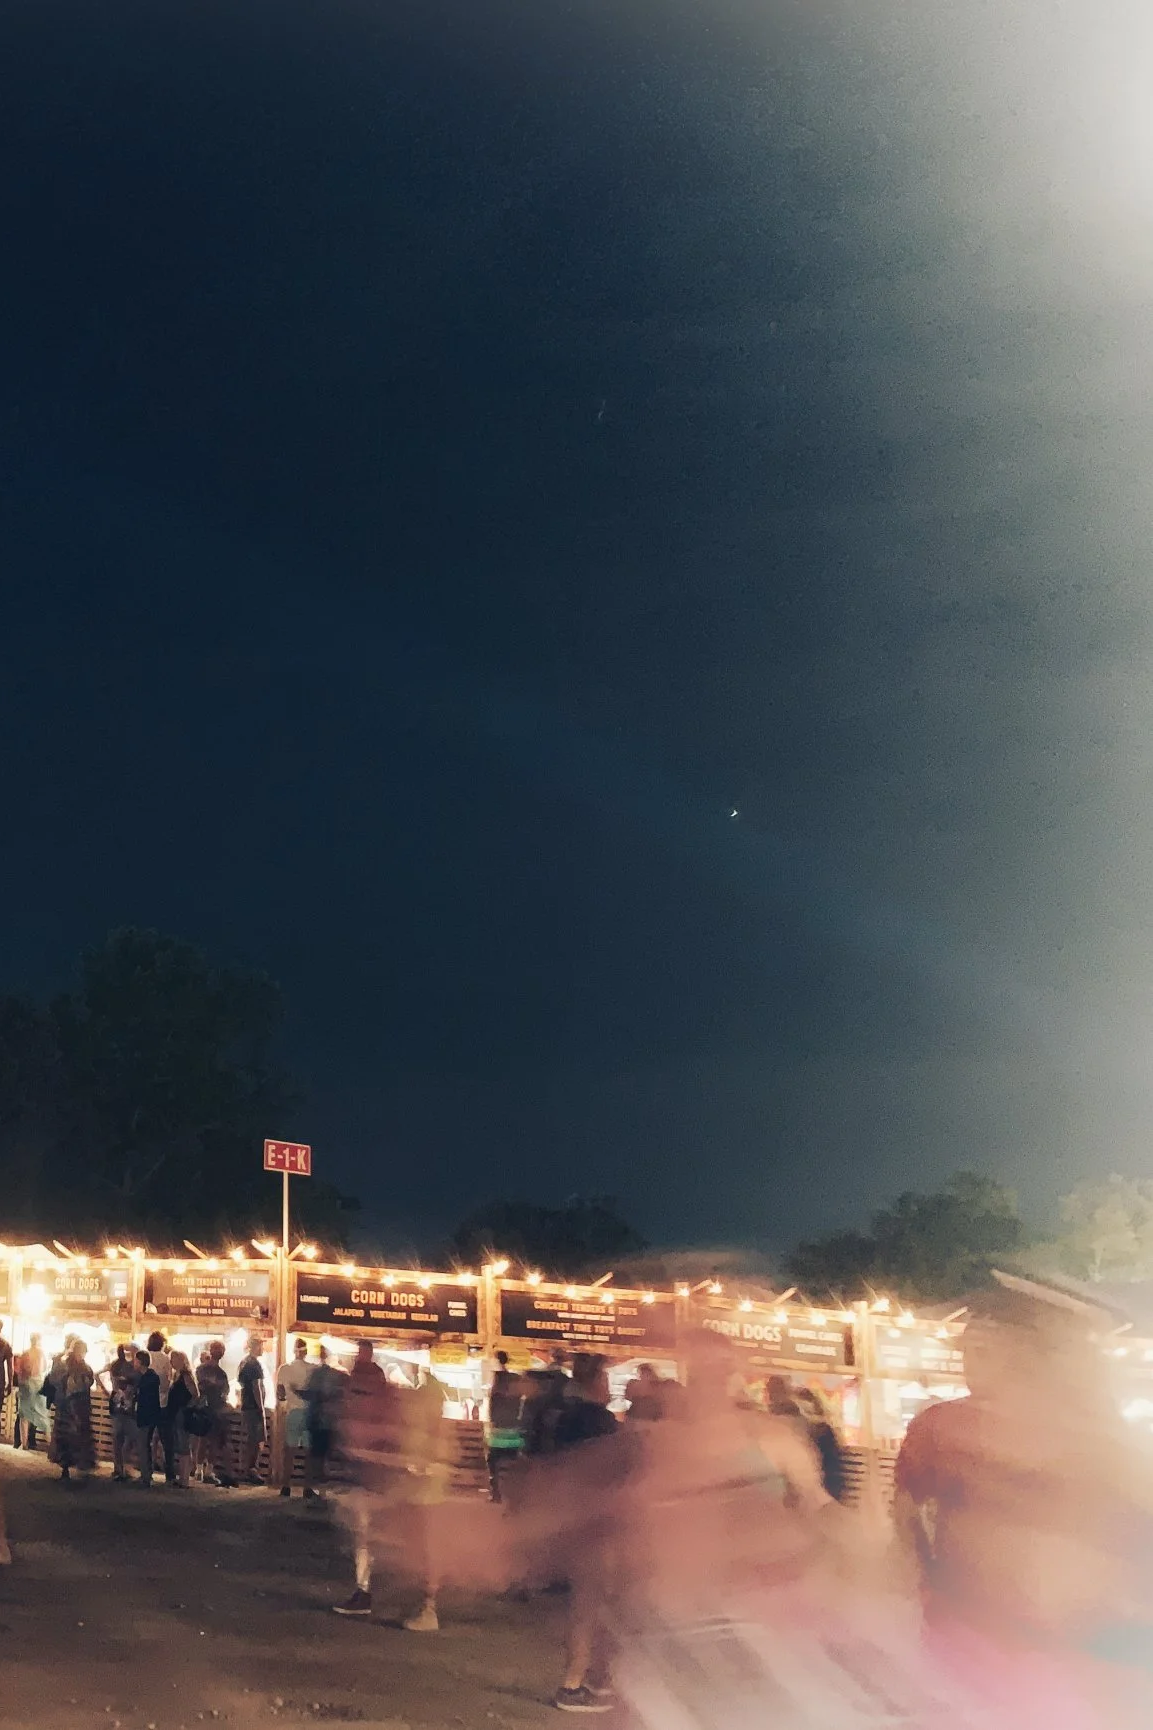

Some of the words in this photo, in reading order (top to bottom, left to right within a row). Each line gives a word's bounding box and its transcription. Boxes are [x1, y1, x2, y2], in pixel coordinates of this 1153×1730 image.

[267, 1144, 307, 1170] E-1-K
[55, 1277, 76, 1289] CORN
[79, 1278, 99, 1290] DOGS
[166, 1296, 196, 1306] BREAKFAST
[213, 1298, 228, 1307] TOTS
[351, 1290, 385, 1305] CORN
[391, 1292, 425, 1308] DOGS
[703, 1319, 740, 1337] CORN
[743, 1323, 782, 1343] DOGS
